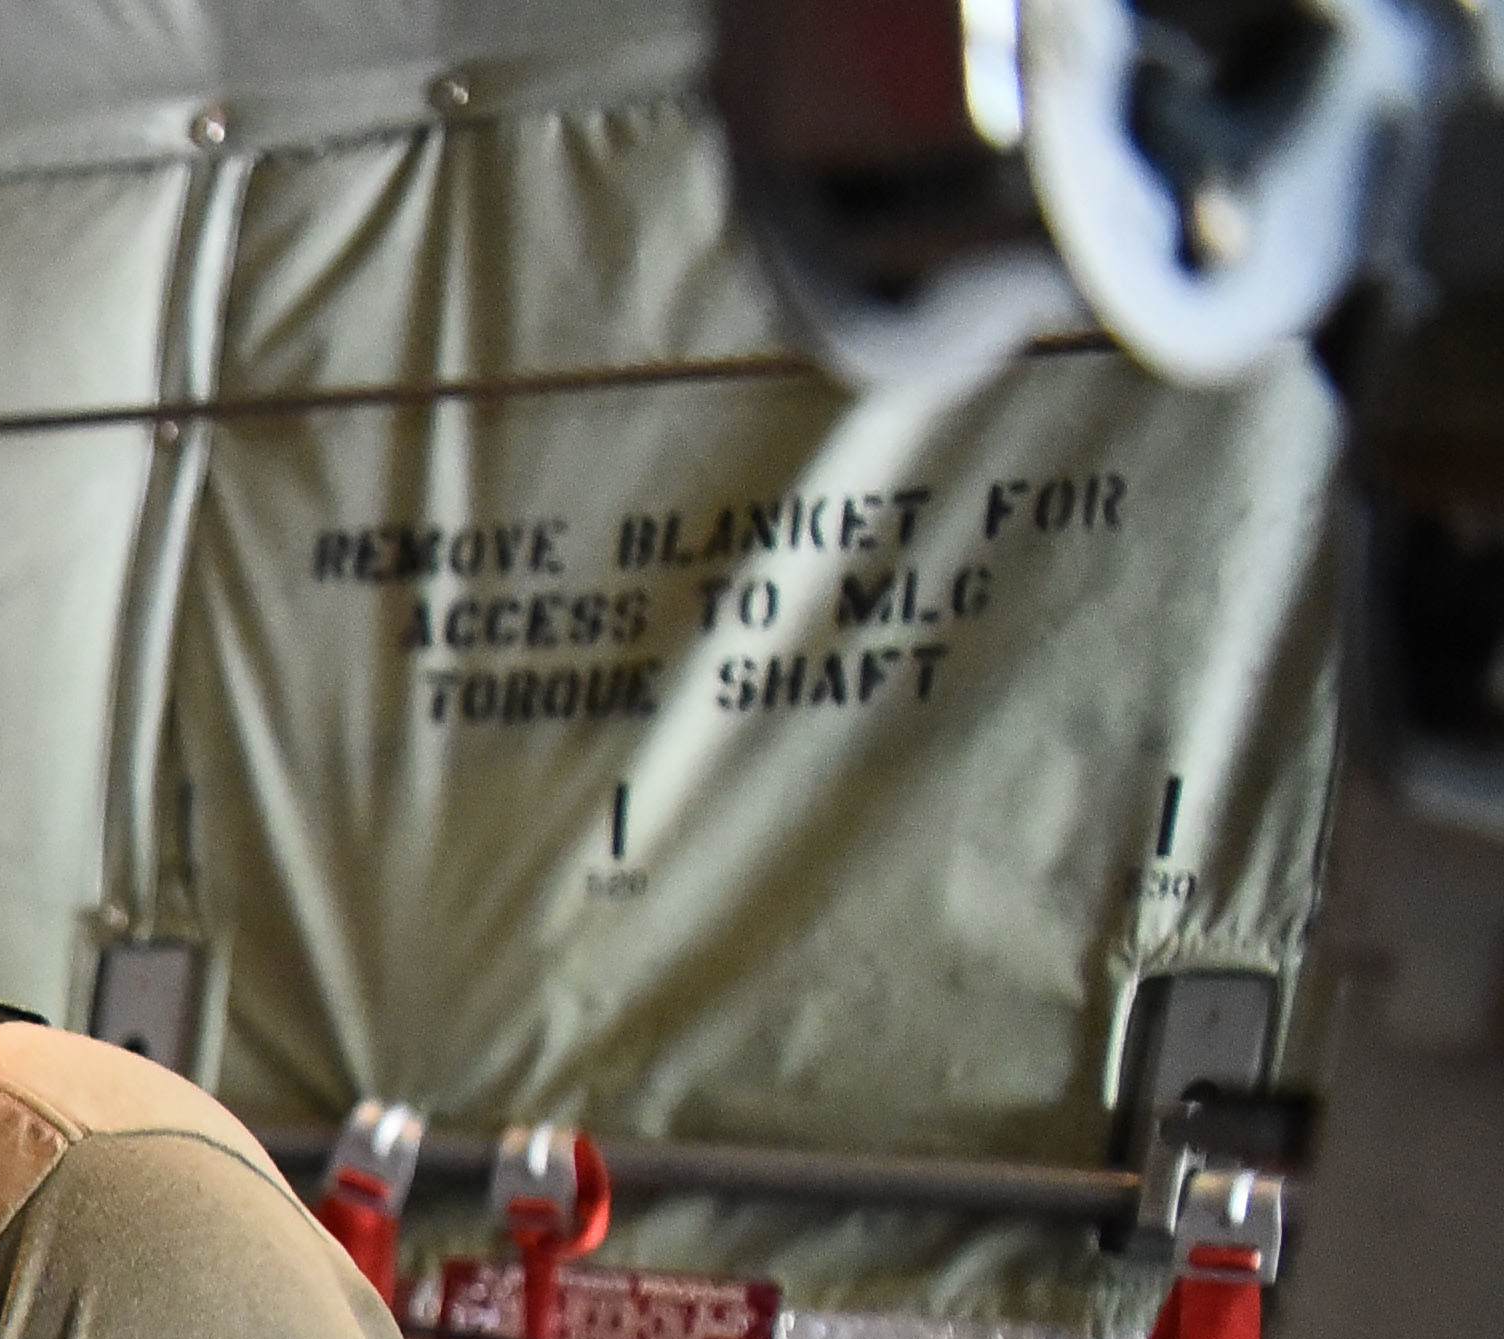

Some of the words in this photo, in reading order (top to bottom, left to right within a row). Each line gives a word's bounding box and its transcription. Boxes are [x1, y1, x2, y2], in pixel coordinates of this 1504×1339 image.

[313, 519, 568, 583] REMOVE
[618, 488, 931, 571] BLANKET
[985, 473, 1128, 539] FOR
[406, 587, 648, 650] ACCESS
[699, 574, 779, 632] TO
[838, 565, 991, 625] MLG
[427, 658, 663, 726] TORQUE
[717, 643, 948, 710] SHAFT
